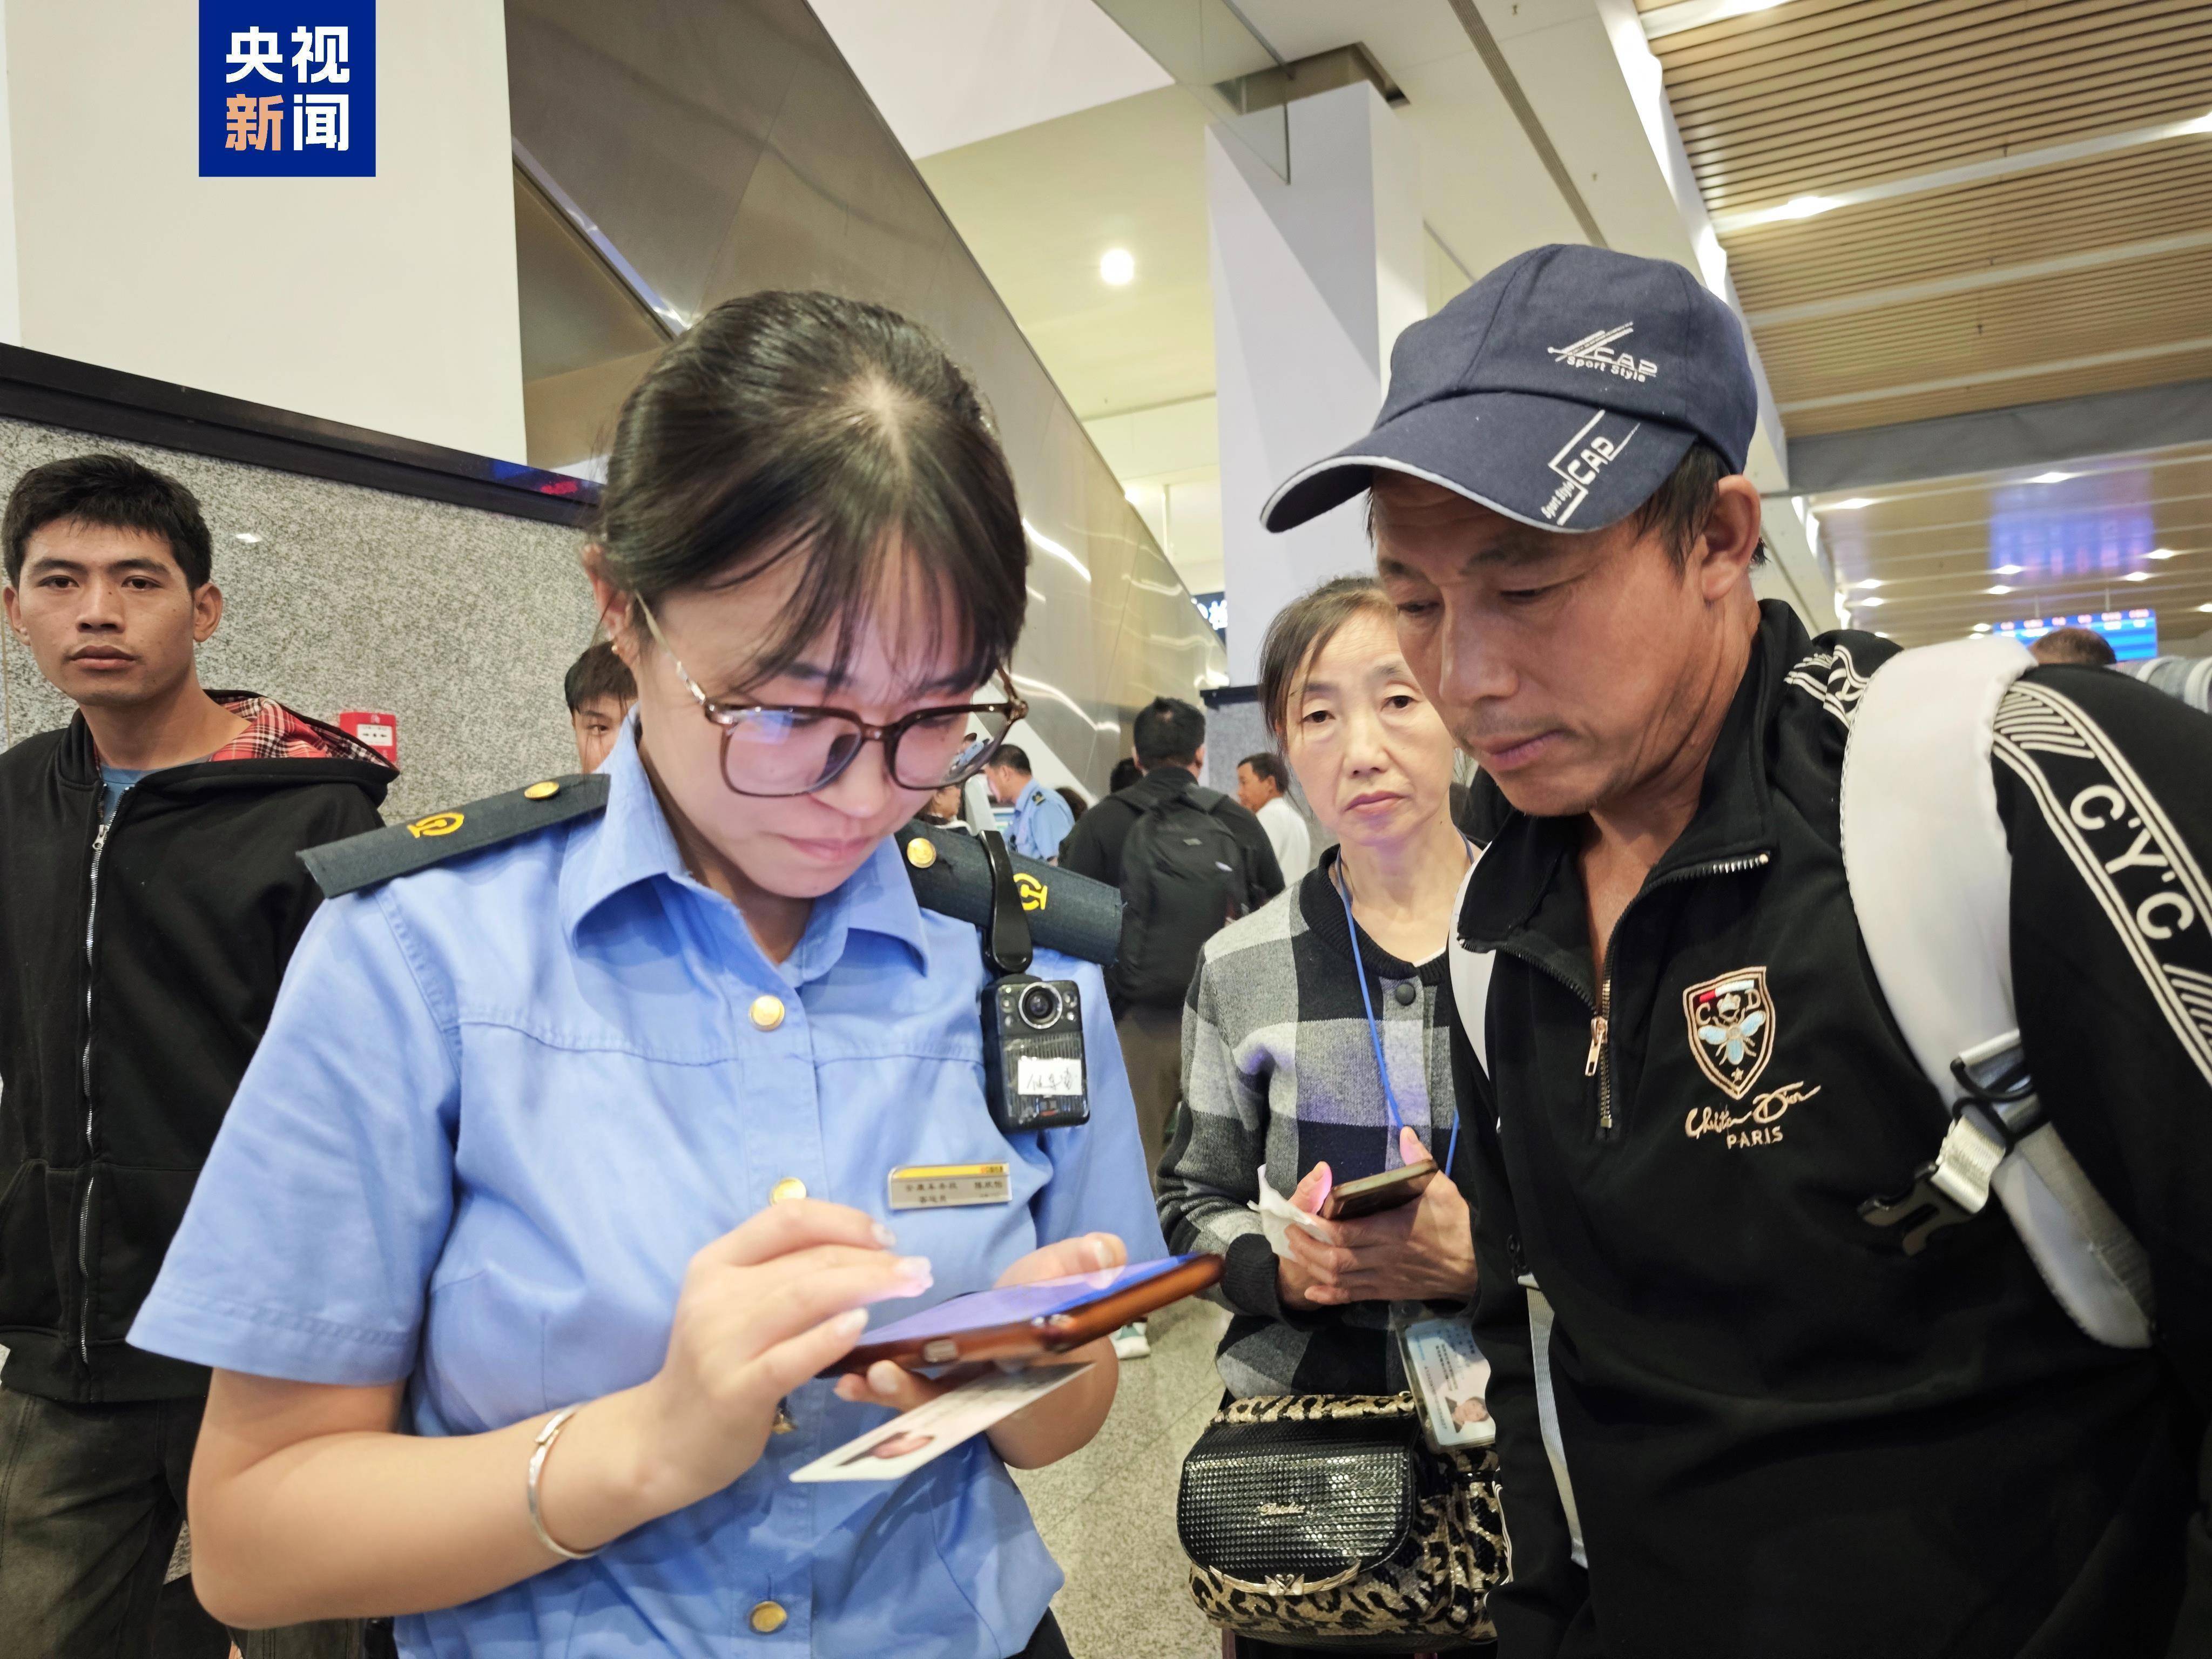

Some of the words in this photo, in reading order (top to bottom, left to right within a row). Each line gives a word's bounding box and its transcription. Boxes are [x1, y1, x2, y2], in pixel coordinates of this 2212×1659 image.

[1567, 355, 1606, 372] Sport
[1610, 364, 1646, 382] Style
[1567, 436, 1615, 485] CAP
[1541, 495, 1562, 519] Sport
[1696, 1002, 1711, 1025] C
[1745, 988, 1761, 1011] D
[1727, 1125, 1783, 1150] PARIS
